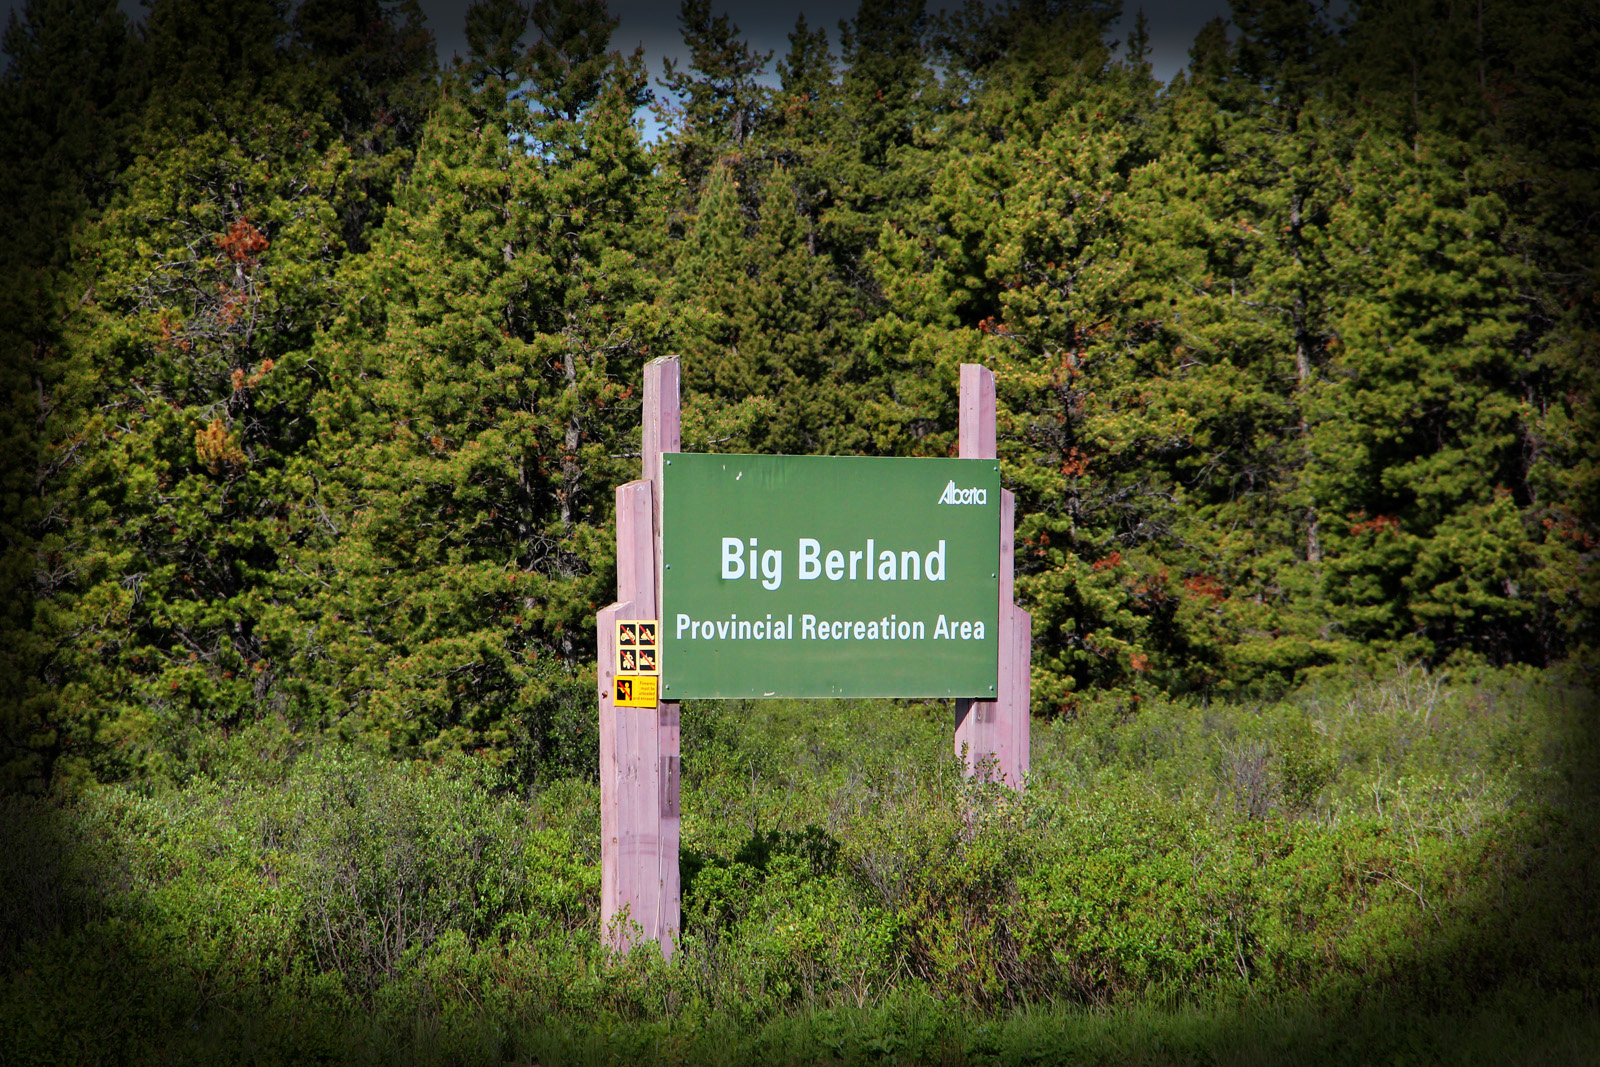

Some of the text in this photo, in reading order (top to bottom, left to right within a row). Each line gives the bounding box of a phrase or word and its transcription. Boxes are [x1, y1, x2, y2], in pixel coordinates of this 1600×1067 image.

[938, 480, 986, 504] Alberta
[722, 537, 945, 590] Big Berland
[676, 614, 984, 640] Provincial Recreation Area
